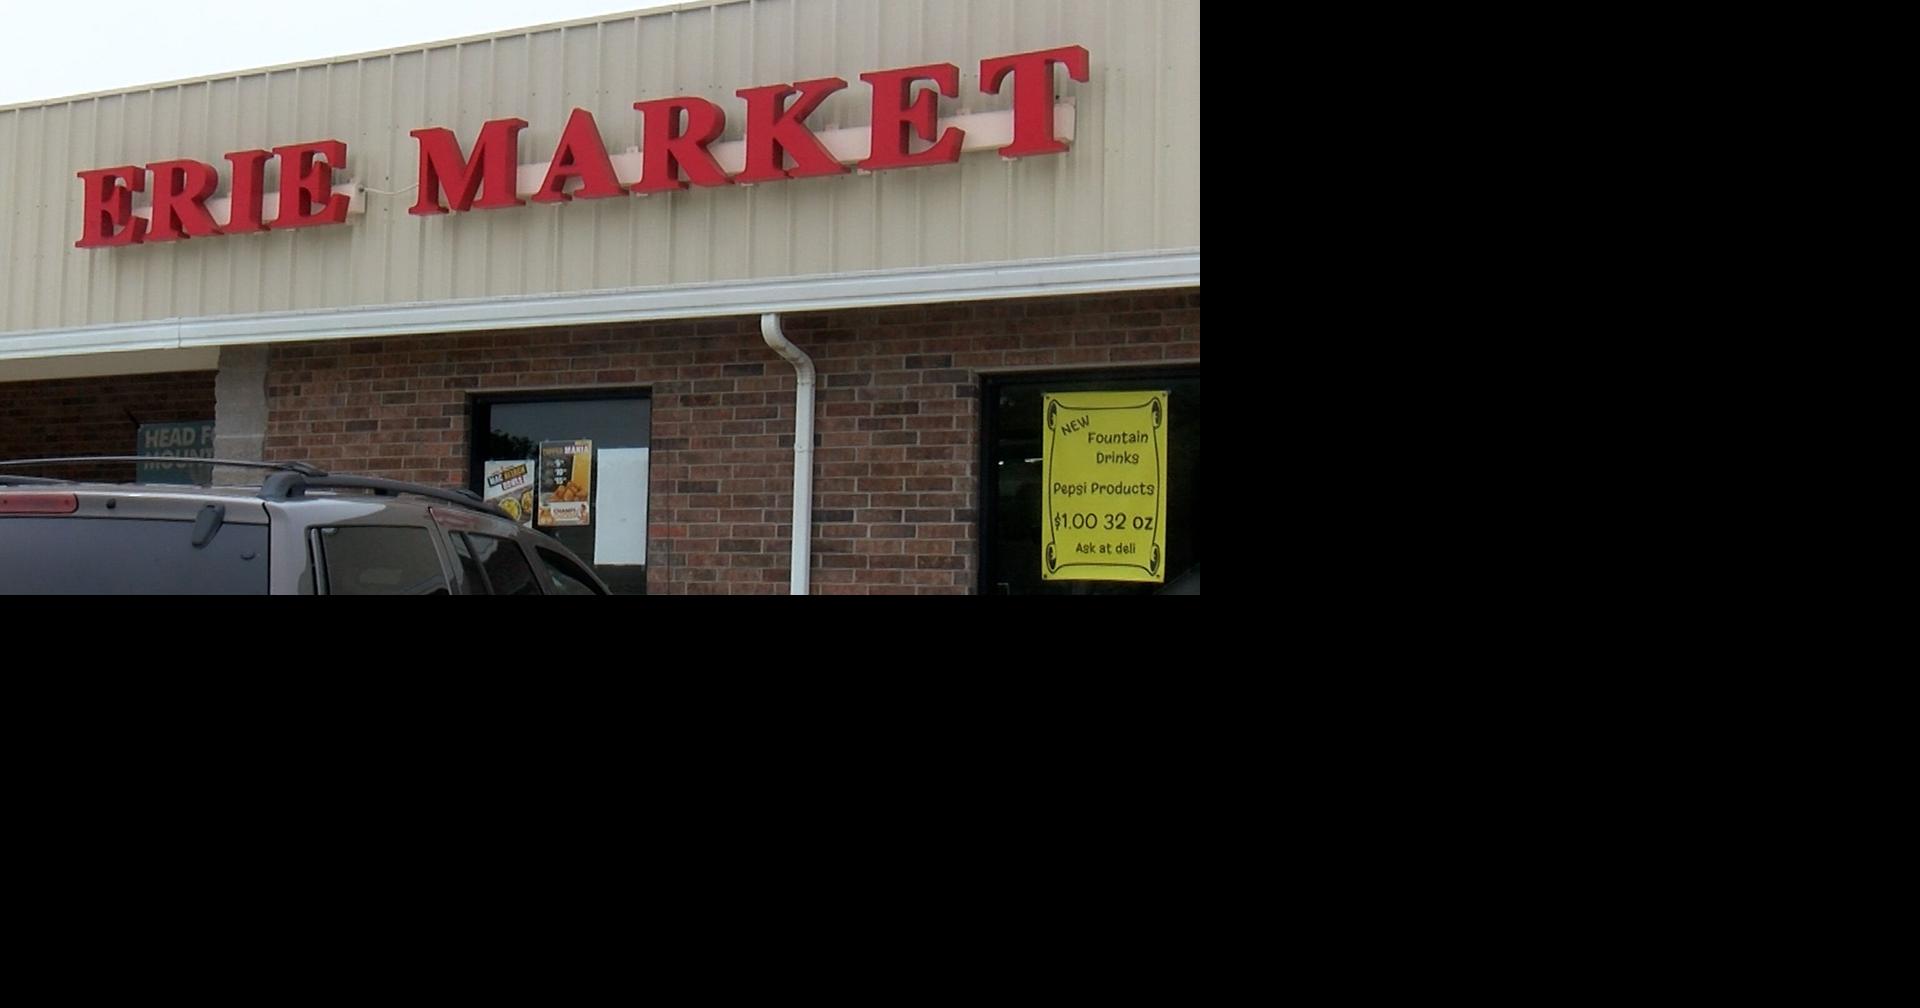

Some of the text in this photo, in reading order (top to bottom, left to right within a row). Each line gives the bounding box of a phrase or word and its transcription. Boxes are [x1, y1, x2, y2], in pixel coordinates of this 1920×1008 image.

[75, 44, 1089, 249] ERIE MARKET
[1061, 415, 1090, 436] NEW
[145, 425, 215, 448] HEAD F
[1088, 430, 1149, 444] Fountain
[1096, 450, 1140, 465] Drinks
[1053, 481, 1155, 498] Pepsi Products
[1054, 511, 1154, 531] $1.00 32 oz
[1075, 542, 1136, 554] Ask at deli
